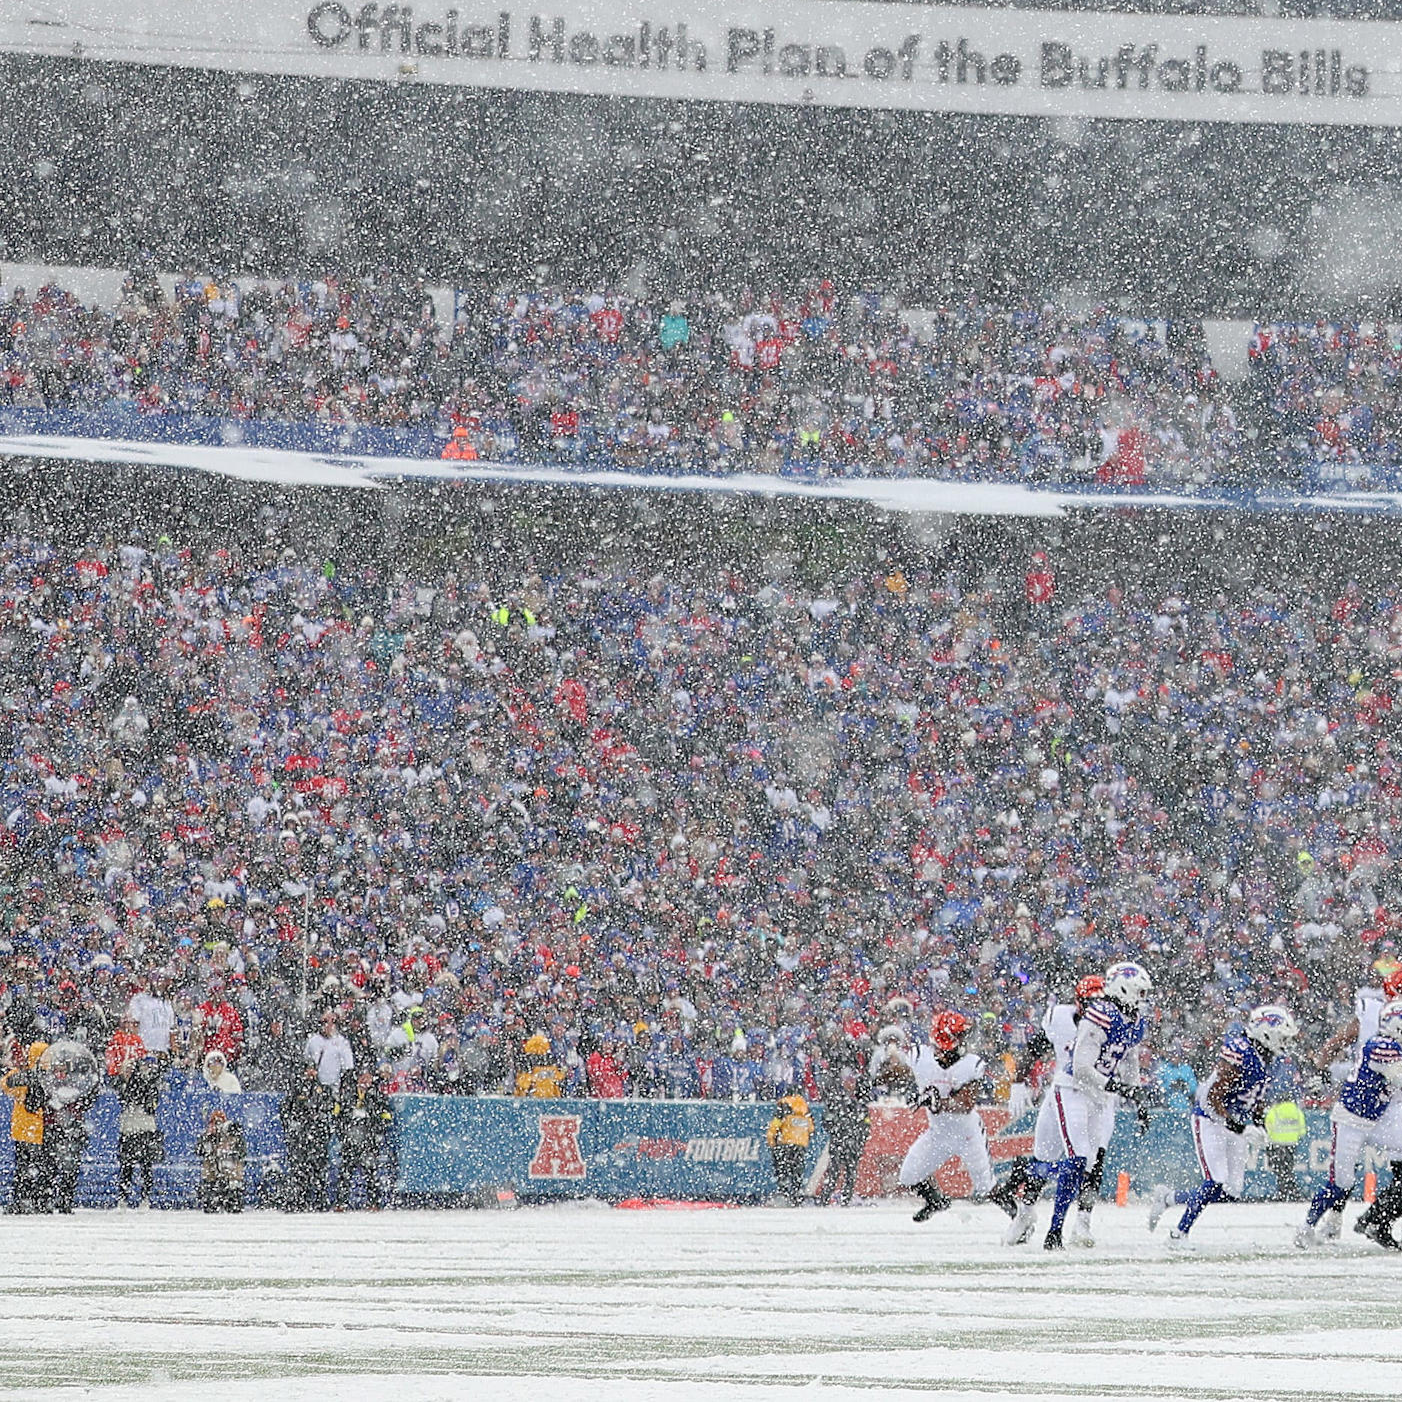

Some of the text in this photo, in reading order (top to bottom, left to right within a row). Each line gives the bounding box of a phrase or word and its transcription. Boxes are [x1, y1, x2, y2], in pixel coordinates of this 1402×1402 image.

[306, 0, 1370, 97] Official Health Plan of the Buffalo Bills
